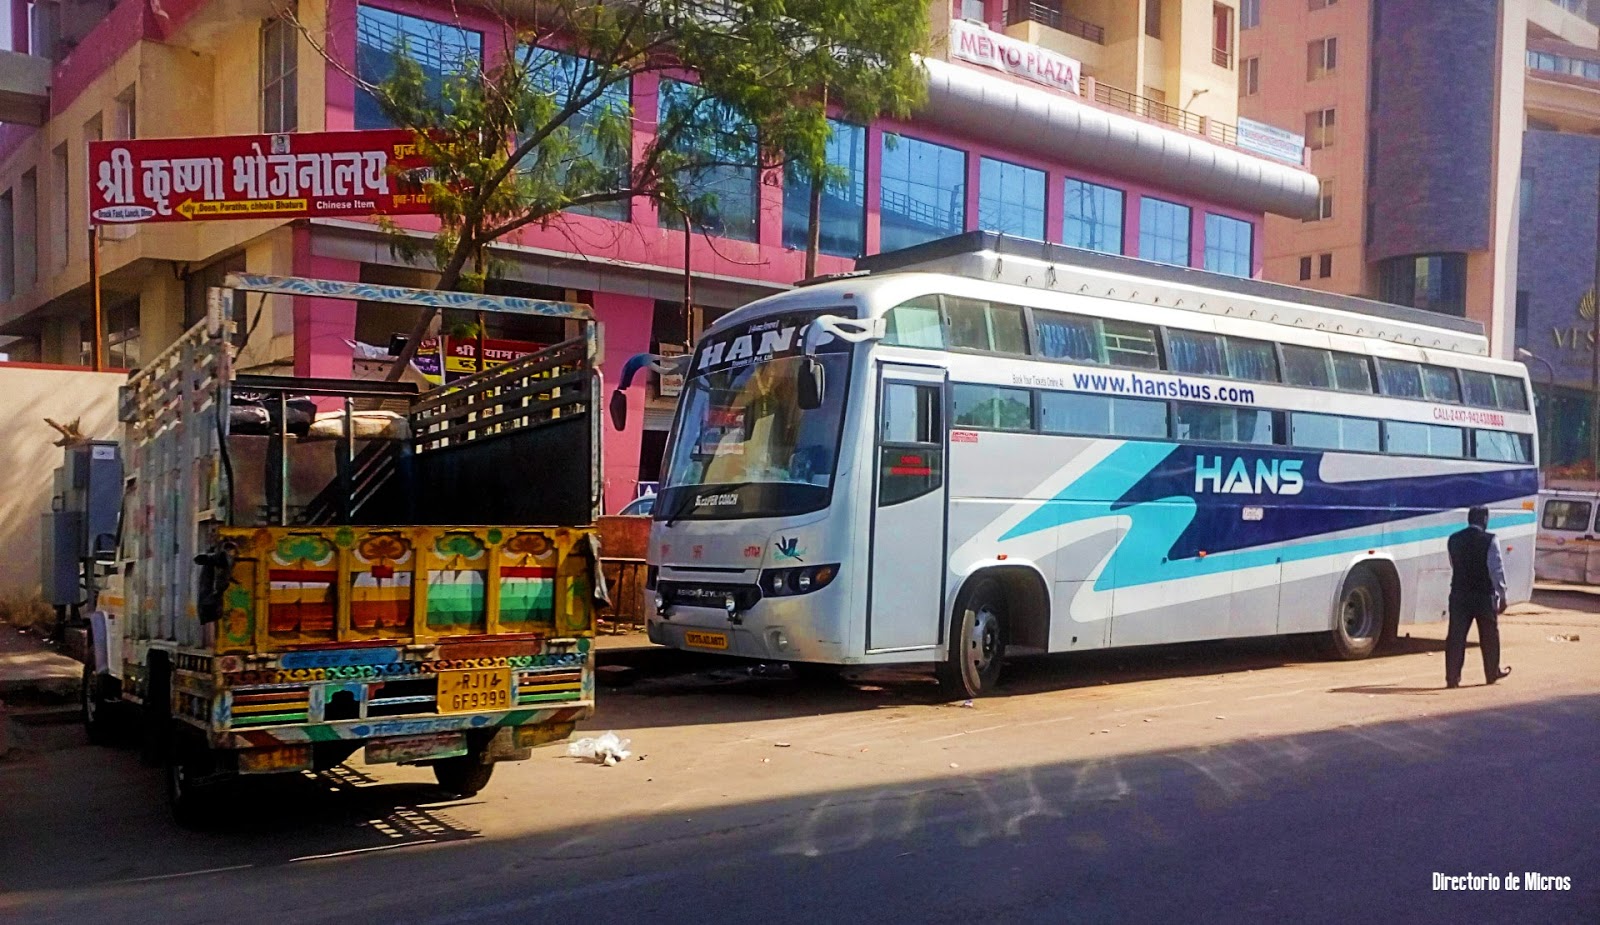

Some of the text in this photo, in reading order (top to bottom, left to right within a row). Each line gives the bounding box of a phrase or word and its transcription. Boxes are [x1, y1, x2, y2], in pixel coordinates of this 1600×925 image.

[1027, 52, 1073, 85] PLAZA
[96, 143, 389, 215] श्री कृष्णा भोजनालय
[317, 200, 375, 209] Chinese Item
[456, 345, 475, 357] श्री
[1072, 372, 1255, 404] www.hansbus.com
[1194, 455, 1304, 495] HANS
[718, 494, 739, 505] COACH
[453, 690, 506, 710] GF9399
